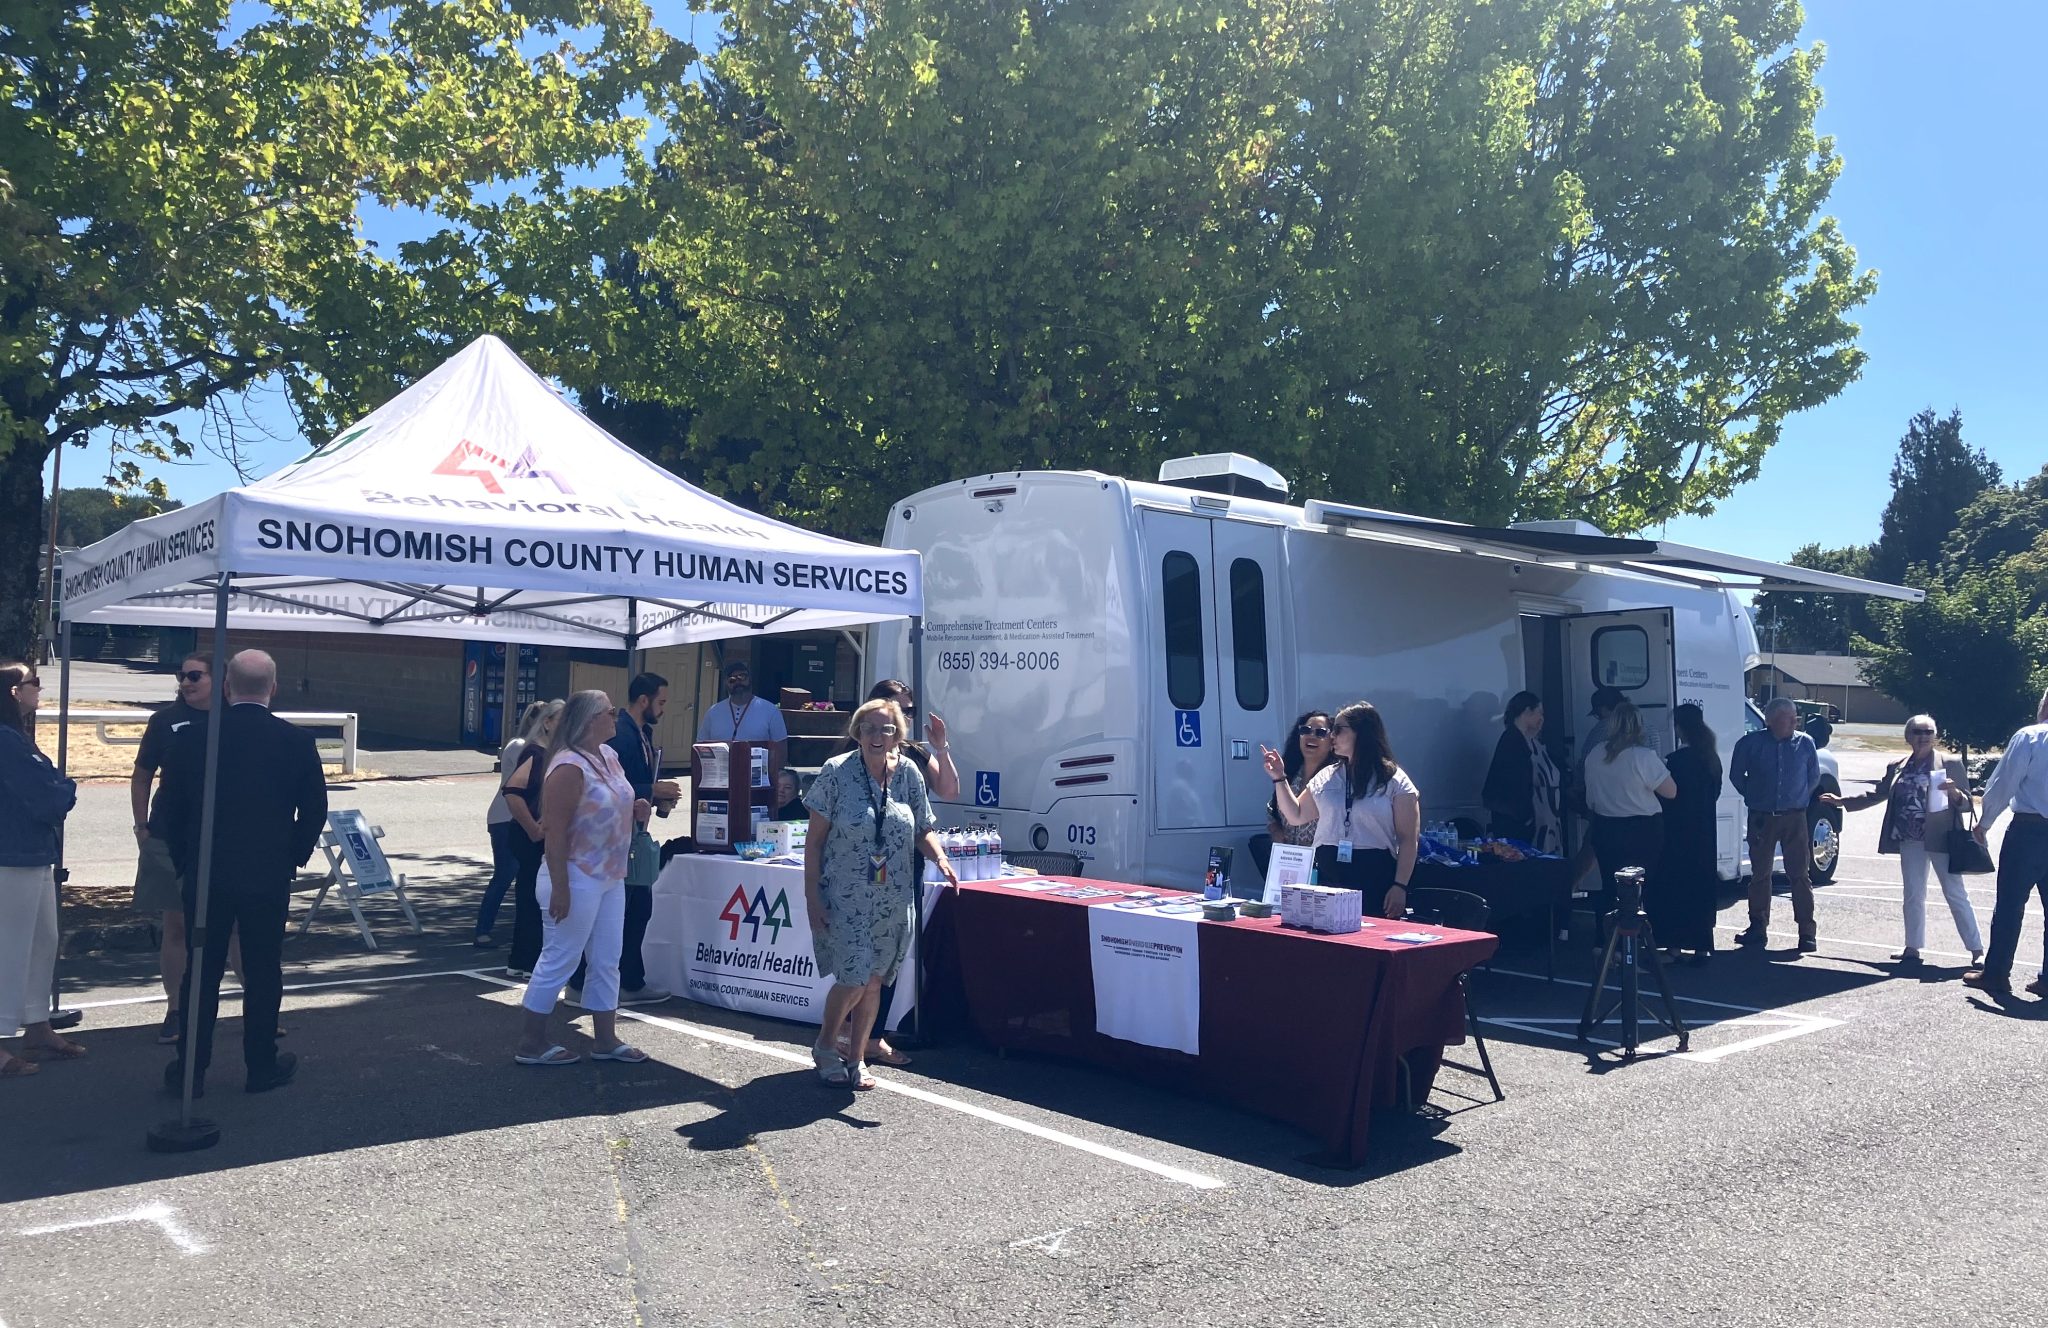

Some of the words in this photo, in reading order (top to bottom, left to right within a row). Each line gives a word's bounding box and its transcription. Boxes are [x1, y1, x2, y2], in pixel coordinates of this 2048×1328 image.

[361, 489, 624, 520] Behavioral
[629, 510, 771, 540] Health
[64, 563, 104, 601] SNOHOMISH
[104, 549, 136, 585] COUNTY
[136, 537, 167, 573] HUMAN
[167, 519, 215, 562] SERVICES
[257, 518, 493, 565] SNOHOMISH
[504, 538, 645, 575] COUNTY
[654, 550, 764, 585] HUMAN
[773, 561, 908, 595] SERVICES
[926, 621, 983, 633] Comprehensive
[985, 620, 1024, 631] Treatment
[1026, 619, 1058, 630] Centers
[926, 634, 944, 642] Mobile
[1066, 631, 1095, 640] Treatment
[938, 651, 975, 672] (855)
[979, 651, 1060, 670] 394-8006
[1067, 824, 1096, 845] 013
[695, 942, 763, 970] Behavioral
[763, 951, 814, 978] Health
[689, 979, 720, 993] SNOHOMISH
[746, 989, 770, 1001] HUMAN
[770, 992, 810, 1007] SERVICES
